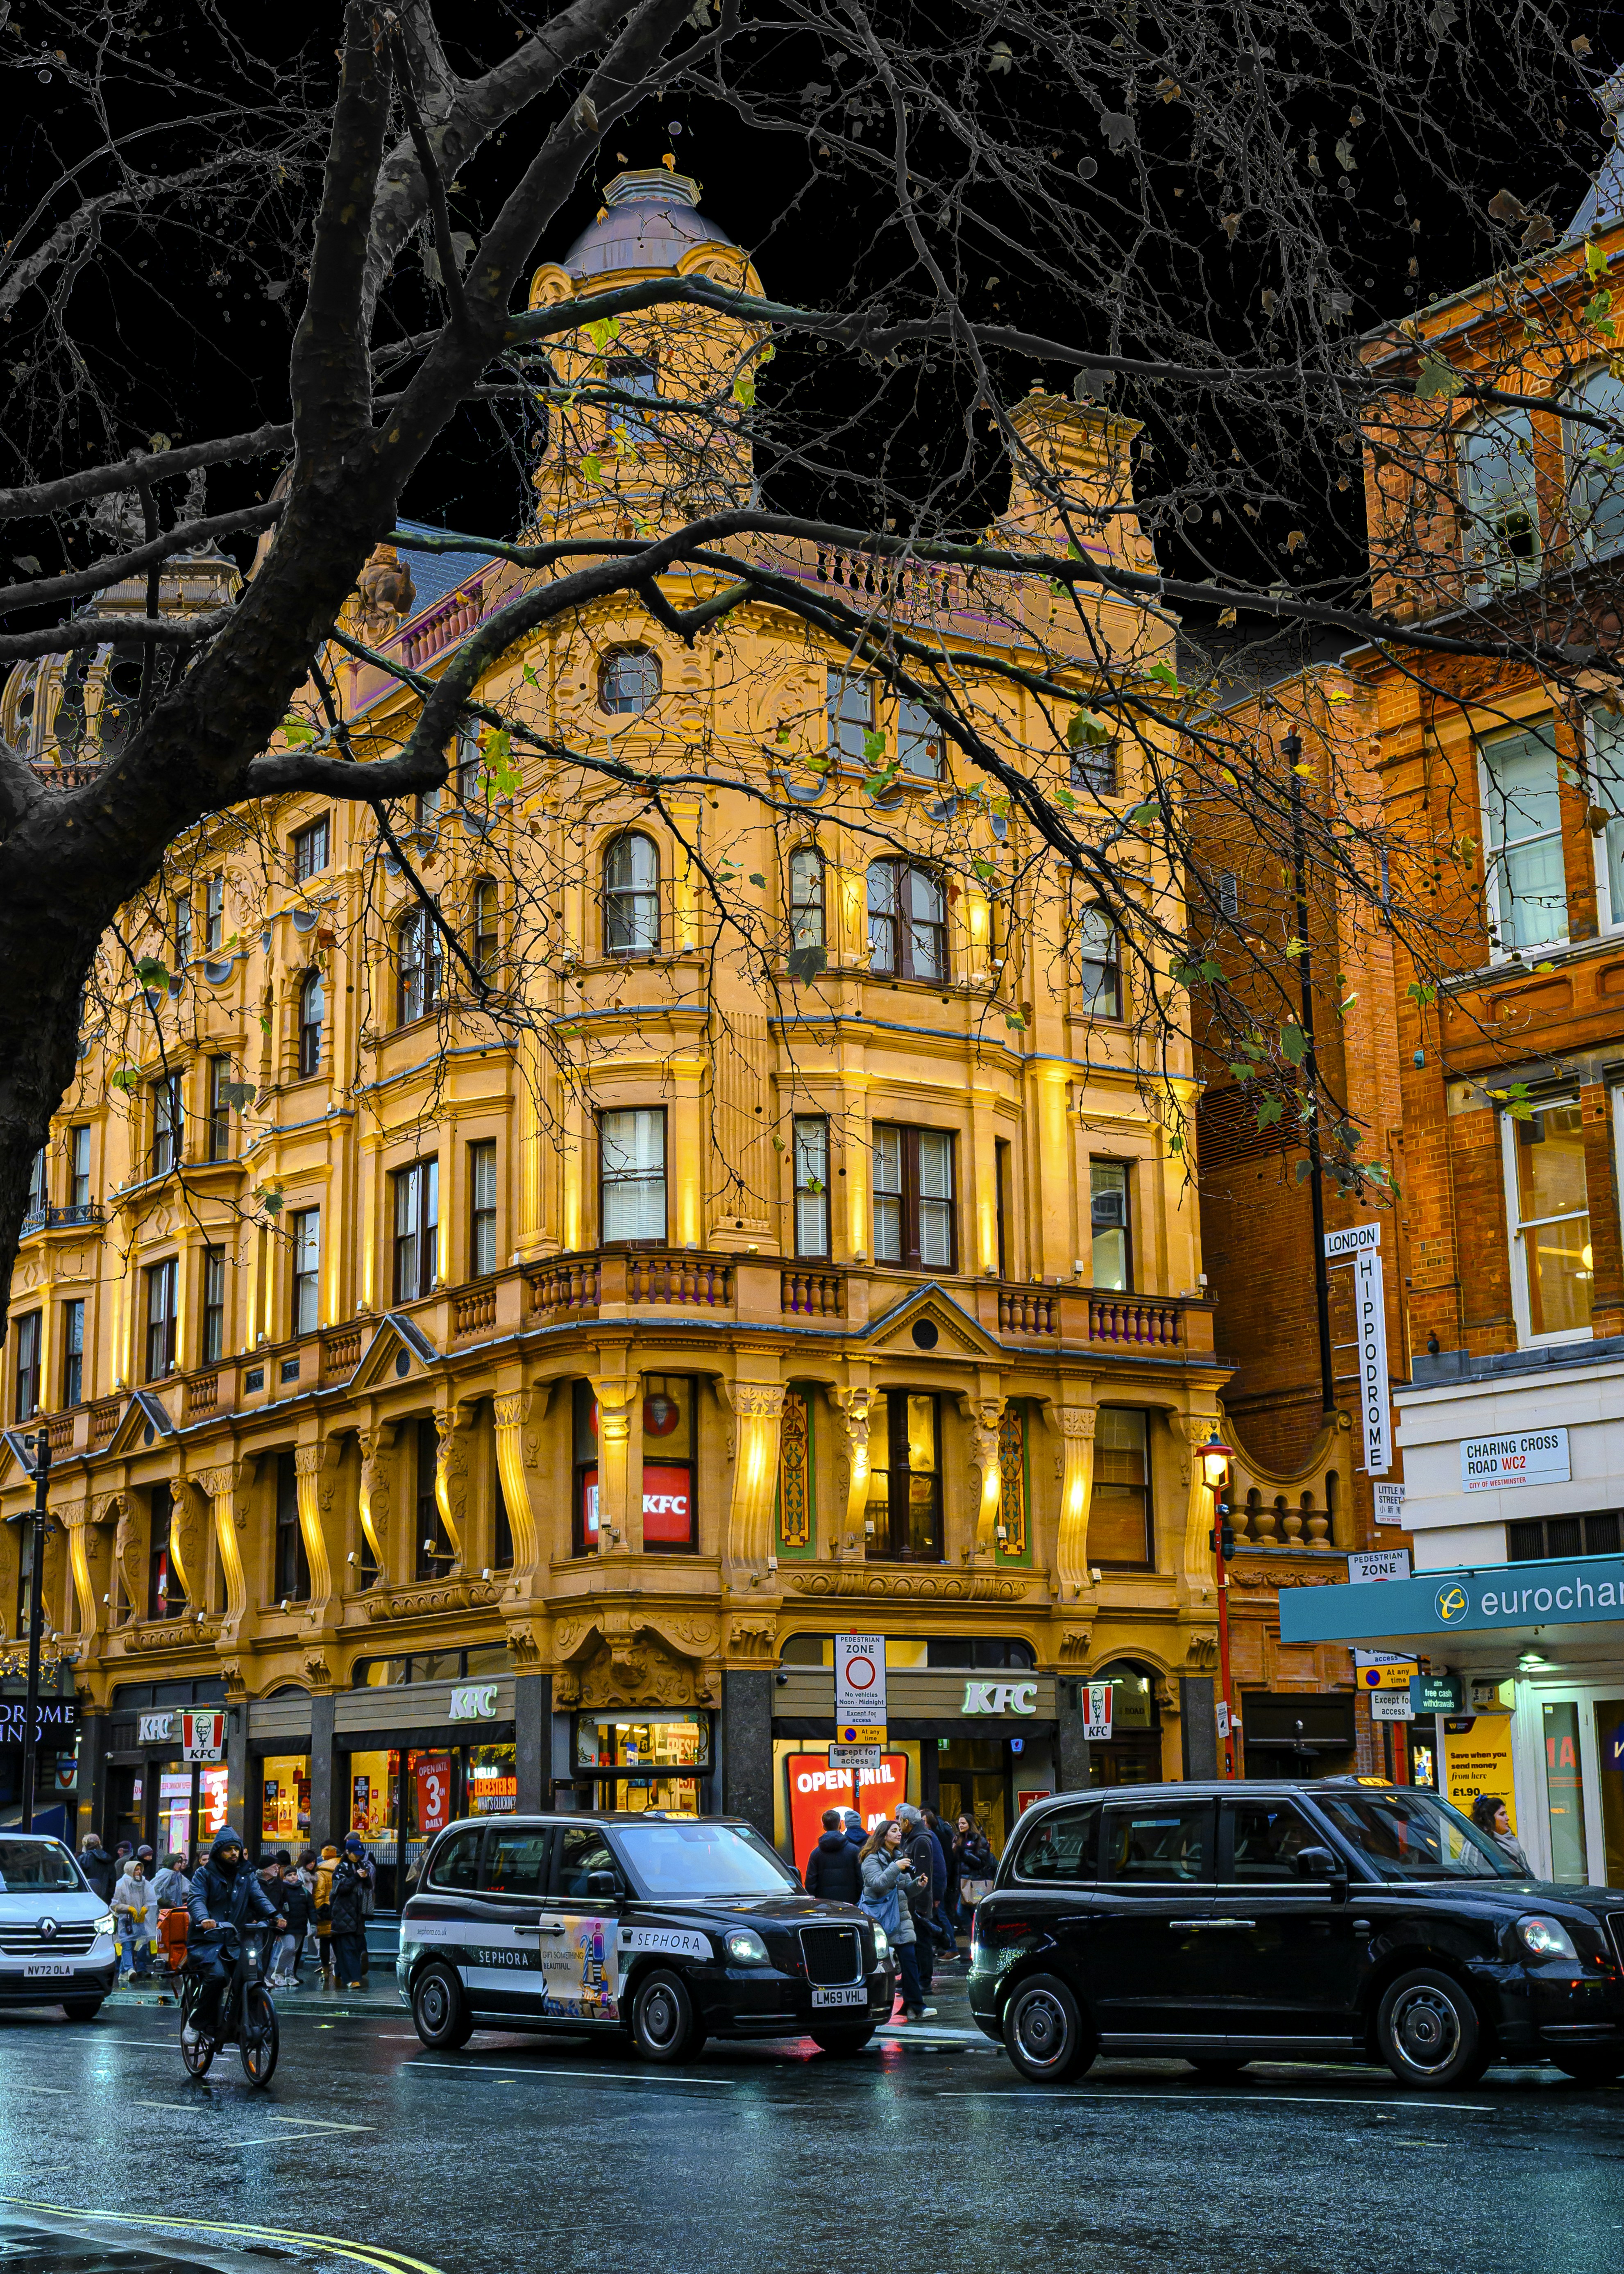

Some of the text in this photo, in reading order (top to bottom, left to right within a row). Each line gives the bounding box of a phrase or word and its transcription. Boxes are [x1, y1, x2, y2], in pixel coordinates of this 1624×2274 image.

[1329, 1227, 1375, 1252] LONDON
[1360, 1259, 1382, 1467] HIPPODROME
[1467, 1435, 1558, 1458] CHARING CROSS
[1468, 1456, 1526, 1474] ROAD WC2
[1490, 1477, 1526, 1486] WESTMINSTER
[1378, 1486, 1398, 1495] LITTLE
[643, 1495, 687, 1514] KFC
[1379, 1495, 1401, 1504] STREET
[1354, 1552, 1403, 1563] PEDESTRIAN
[1361, 1563, 1397, 1576] ZONE
[846, 1645, 874, 1653] ZONE
[963, 1683, 1038, 1713] KFC
[1425, 1688, 1452, 1697] free cash
[449, 1686, 496, 1719] KFC
[1375, 1695, 1410, 1705] Except fo
[1423, 1699, 1454, 1708] withdrawals
[139, 1714, 173, 1740] KFC
[1088, 1726, 1107, 1737] KFC
[189, 1749, 215, 1759] KFC
[419, 1762, 448, 1776] OPEN UNTIL
[474, 1766, 498, 1779] HELLO
[797, 1768, 853, 1793] OPEN
[1450, 1772, 1469, 1781] from
[439, 1787, 445, 1796] AM
[475, 1778, 507, 1796] LEICESTER
[1453, 1788, 1480, 1797] £1.90
[426, 1775, 441, 1816] 3
[425, 1817, 443, 1829] DAILY
[417, 1927, 447, 1937] sephora.co.uk
[637, 1933, 700, 1950] SEPHORA
[479, 1950, 528, 1965] SEPHORA
[553, 1951, 584, 1960] SOMETHING
[28, 1965, 70, 1975] NV72 OLA
[817, 1990, 863, 2004] LM69 VHL
